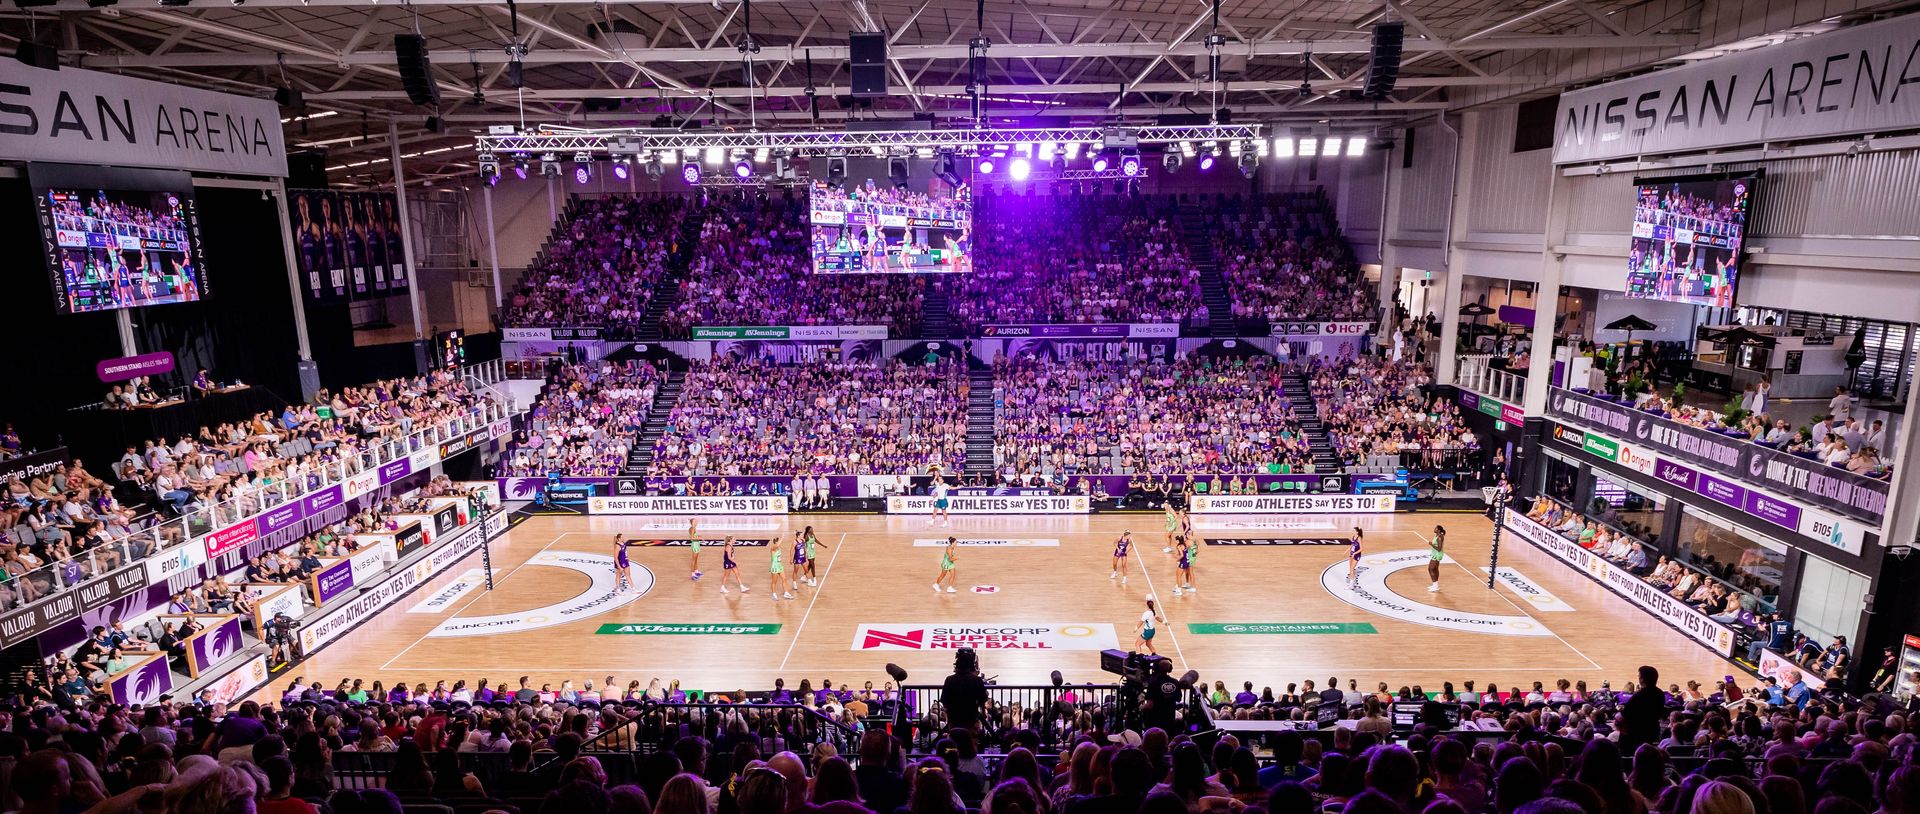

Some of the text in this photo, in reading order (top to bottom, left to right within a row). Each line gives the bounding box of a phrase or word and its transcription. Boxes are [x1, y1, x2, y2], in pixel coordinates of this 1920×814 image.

[1563, 40, 1920, 148] NISSAN ARENA
[156, 104, 272, 157] ARENA
[38, 195, 66, 309] NISSAN ARENA
[188, 199, 210, 295] NISSAN ARENA
[553, 329, 573, 337] VALOUR
[578, 329, 598, 337] VALOUR
[996, 327, 1029, 335] AURIZON
[1339, 324, 1364, 333] HCF
[104, 364, 128, 374] SOUTHERN
[128, 362, 142, 372] STAND
[498, 422, 510, 434] HCF
[1562, 430, 1584, 442] AURIZON
[1632, 455, 1651, 471] origin
[357, 477, 374, 491] origin
[1766, 459, 1852, 504] HOME OF THE QUEENSLAND
[652, 499, 708, 510] ATHLETES
[725, 499, 747, 510] YES
[749, 499, 768, 510] TO!
[951, 499, 1008, 510] ATHLETES
[1026, 499, 1048, 510] YES
[1051, 499, 1070, 510] TO!
[1255, 498, 1313, 509] ATHLETES
[1331, 498, 1353, 509] YES
[1356, 498, 1376, 509] TO!
[1813, 521, 1832, 537] B105
[433, 554, 443, 567] FAST
[443, 548, 453, 560] FOOD
[453, 530, 478, 557] ATHLETES
[494, 517, 502, 532] TO!
[1512, 516, 1589, 567] FAST FOOD ATHLETES SAY YES TO!
[68, 566, 77, 577] S7
[162, 556, 179, 573] B105
[354, 555, 380, 572] NISSAN
[116, 567, 143, 589] VALOUR
[1498, 571, 1540, 595] SUNCORP
[81, 580, 111, 604] VALOUR
[428, 582, 468, 608] SUNCORP
[43, 595, 74, 620] VALOUR
[316, 570, 415, 639] FAST FOOD ATHLETES SAY YES TO!
[1374, 600, 1416, 613] SHOT
[1609, 570, 1717, 642] FAST FOOD ATHLETES SAY YES TO!
[0, 611, 36, 638] VALOUR
[445, 619, 520, 631] SUNCORP
[1425, 615, 1503, 626] SUNCORP
[615, 624, 762, 634] AVJennings
[932, 627, 1051, 635] SUNCORP
[930, 641, 1053, 649] NETBALL
